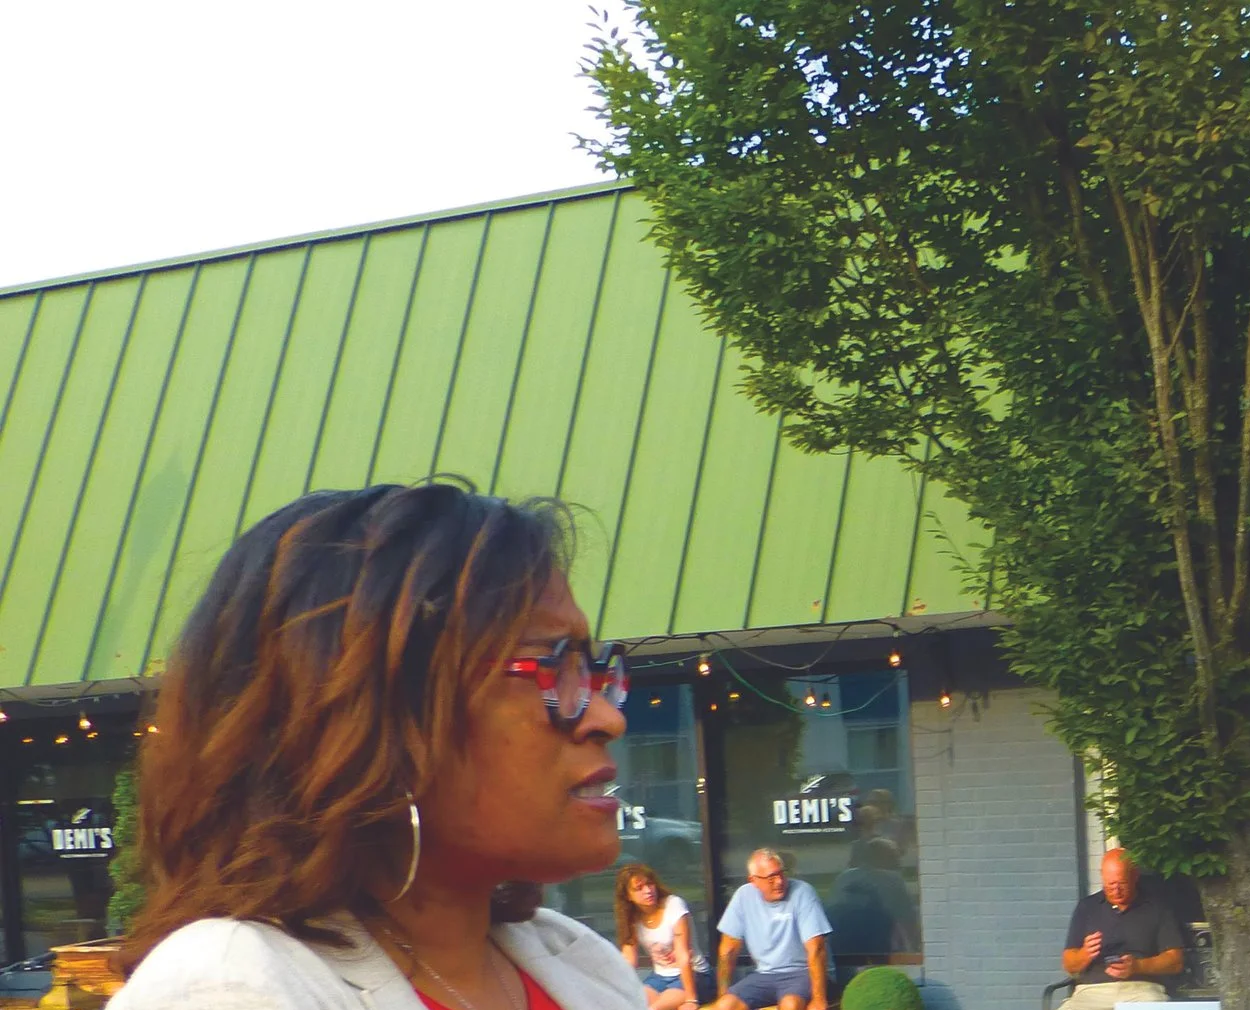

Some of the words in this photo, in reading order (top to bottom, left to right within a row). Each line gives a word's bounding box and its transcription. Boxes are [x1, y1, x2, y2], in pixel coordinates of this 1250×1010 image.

[616, 805, 646, 830] I'S
[773, 797, 853, 825] DEMI'S
[52, 827, 113, 850] DEMI'S
